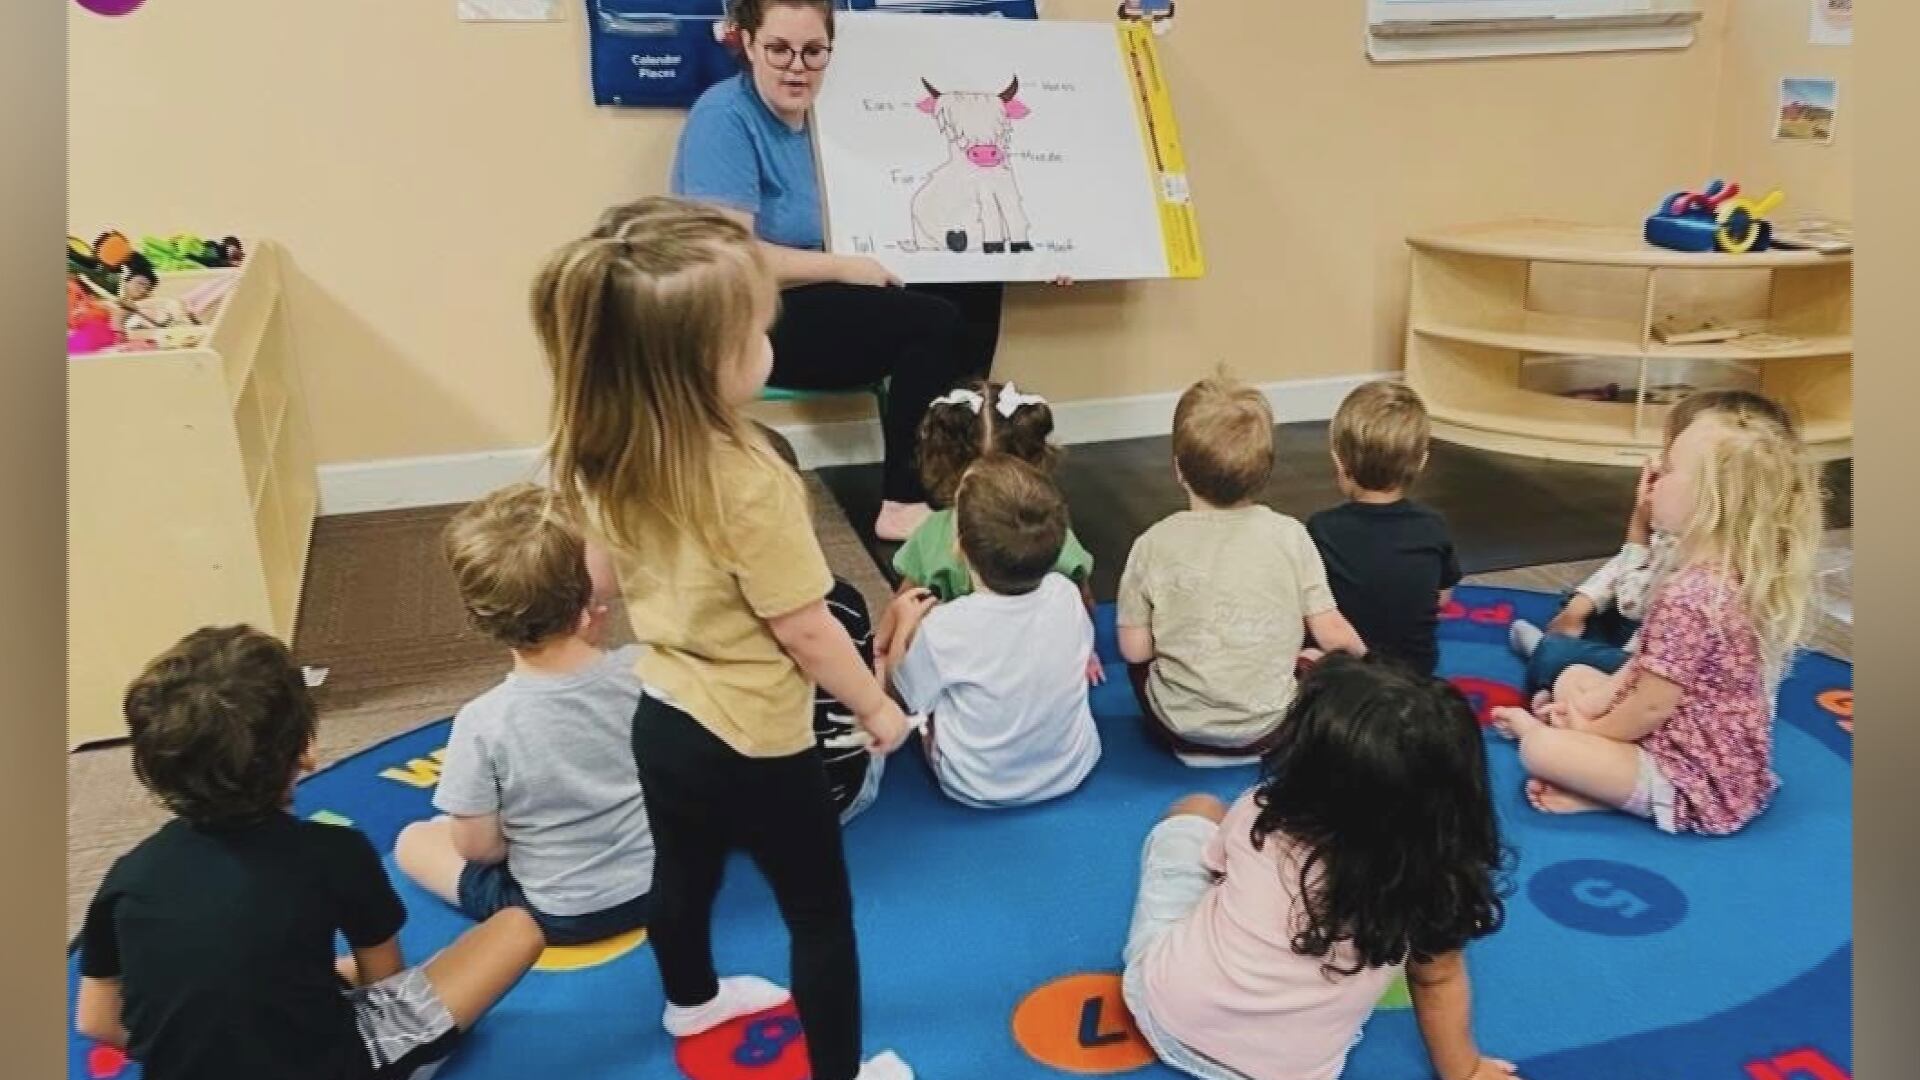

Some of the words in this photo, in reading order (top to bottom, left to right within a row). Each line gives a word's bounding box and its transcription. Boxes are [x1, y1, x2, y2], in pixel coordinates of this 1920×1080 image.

[631, 54, 682, 66] Calendar
[638, 67, 676, 78] Places
[1572, 878, 1652, 919] 5
[732, 1014, 801, 1068] 8
